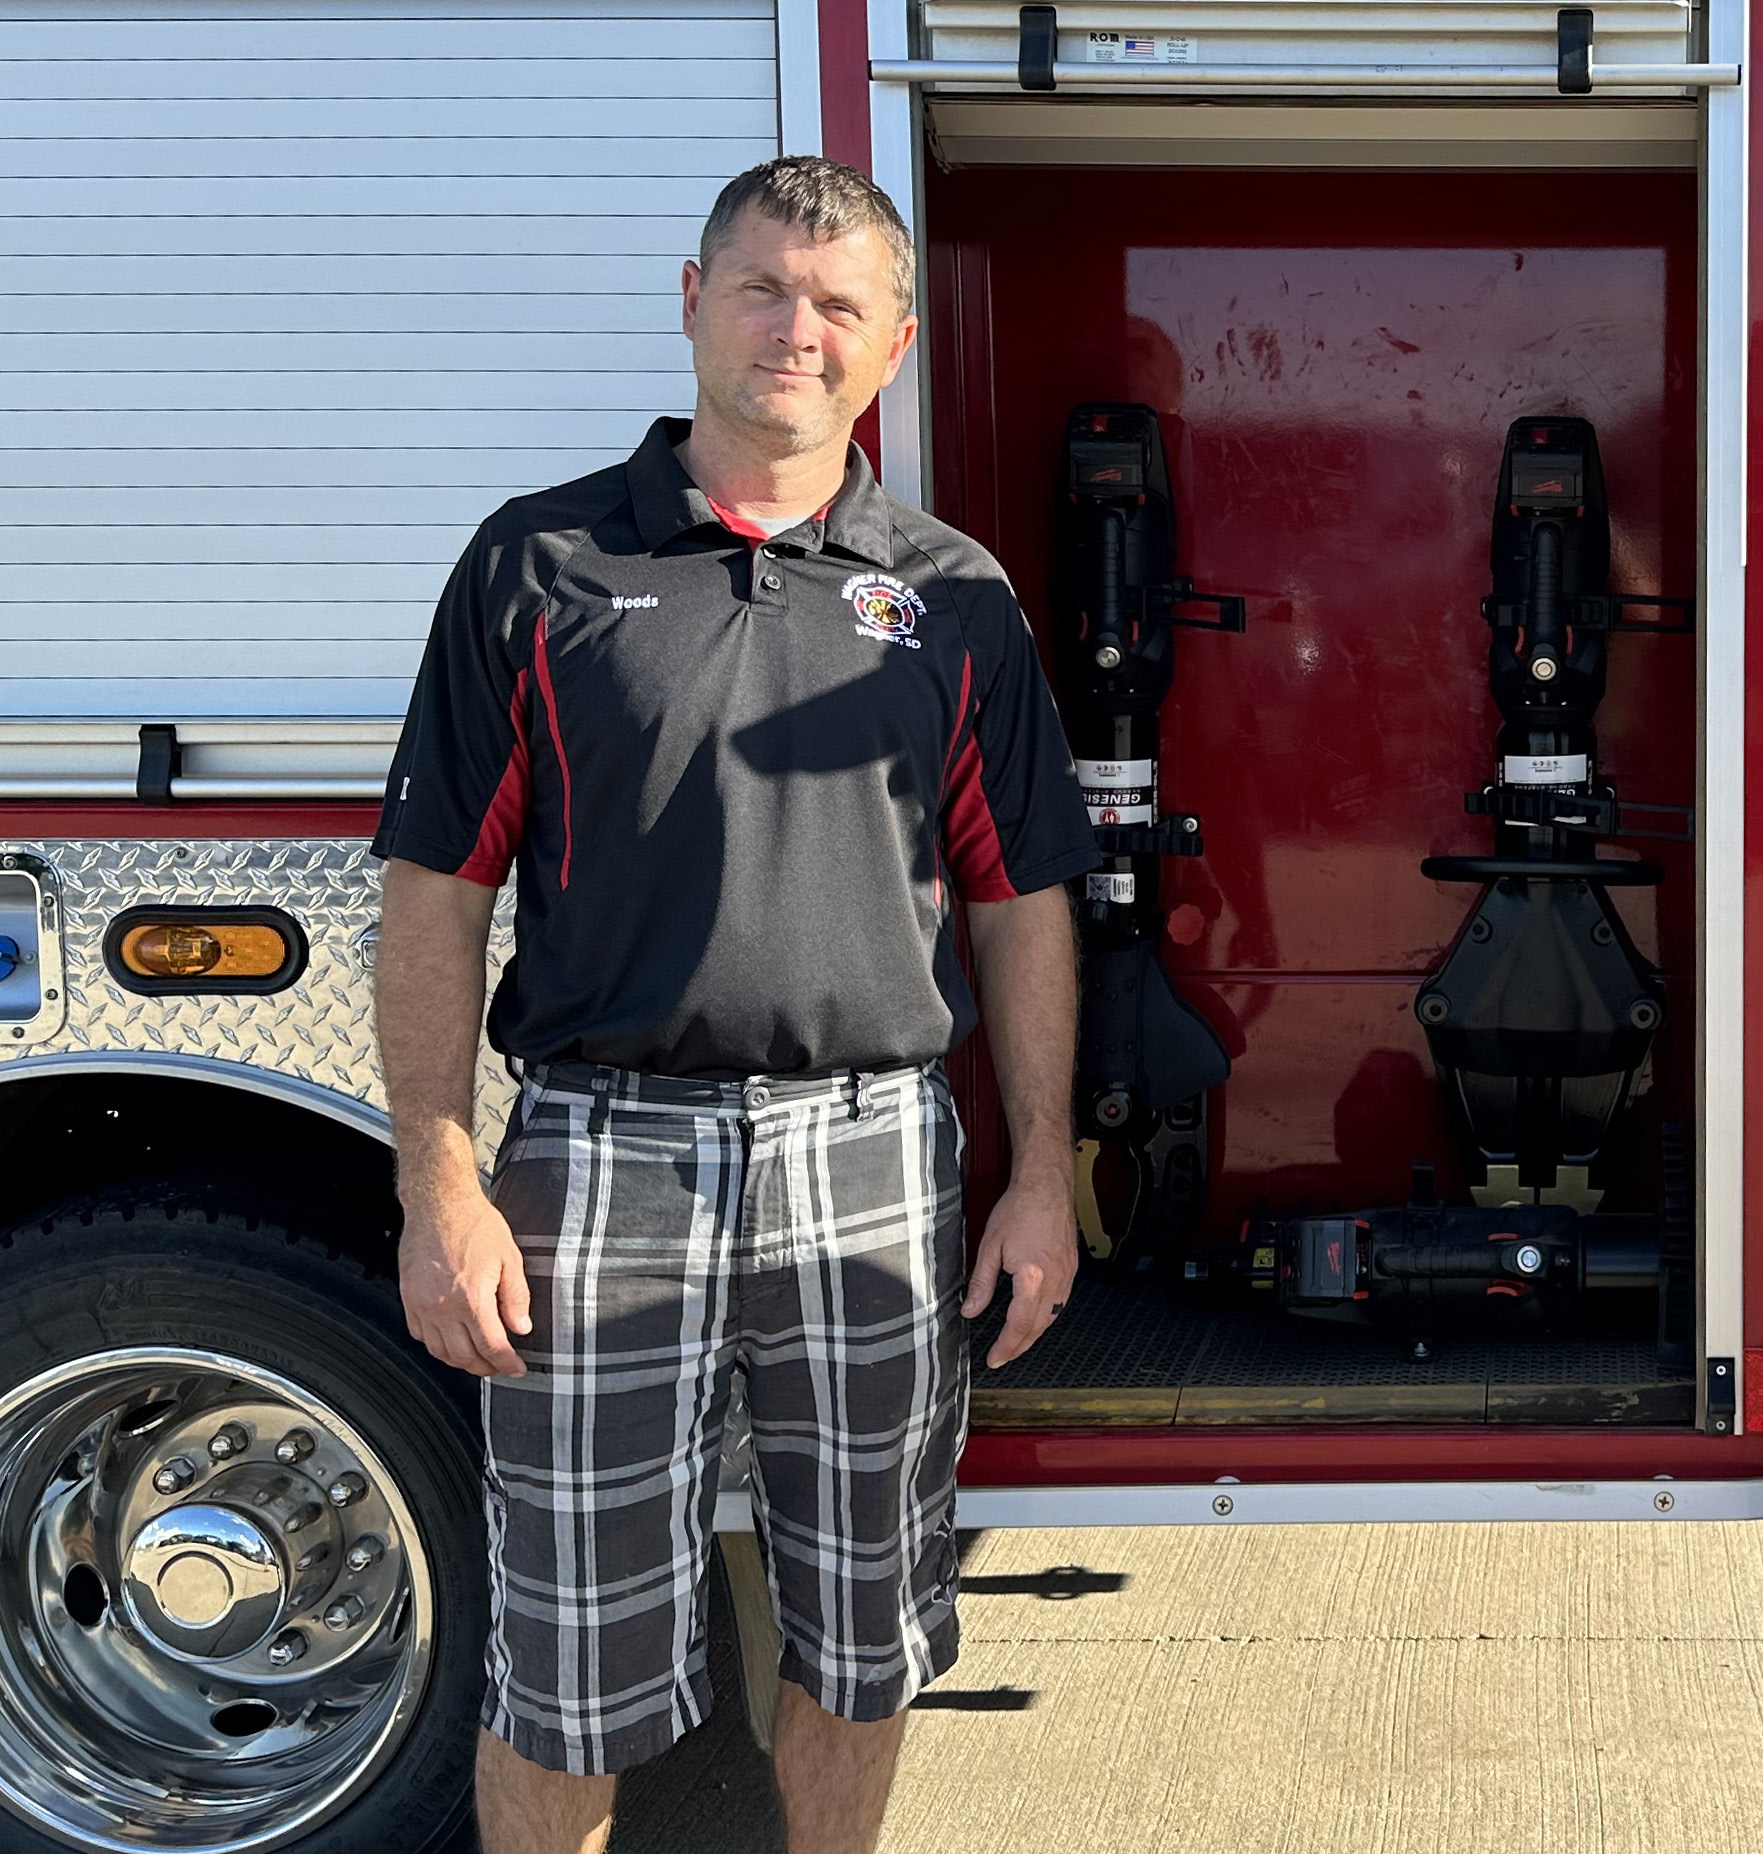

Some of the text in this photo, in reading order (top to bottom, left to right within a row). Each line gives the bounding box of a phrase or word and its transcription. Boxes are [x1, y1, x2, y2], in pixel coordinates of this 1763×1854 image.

[611, 594, 659, 610] Woods
[904, 588, 927, 616] DEPT.
[904, 637, 922, 649] SD
